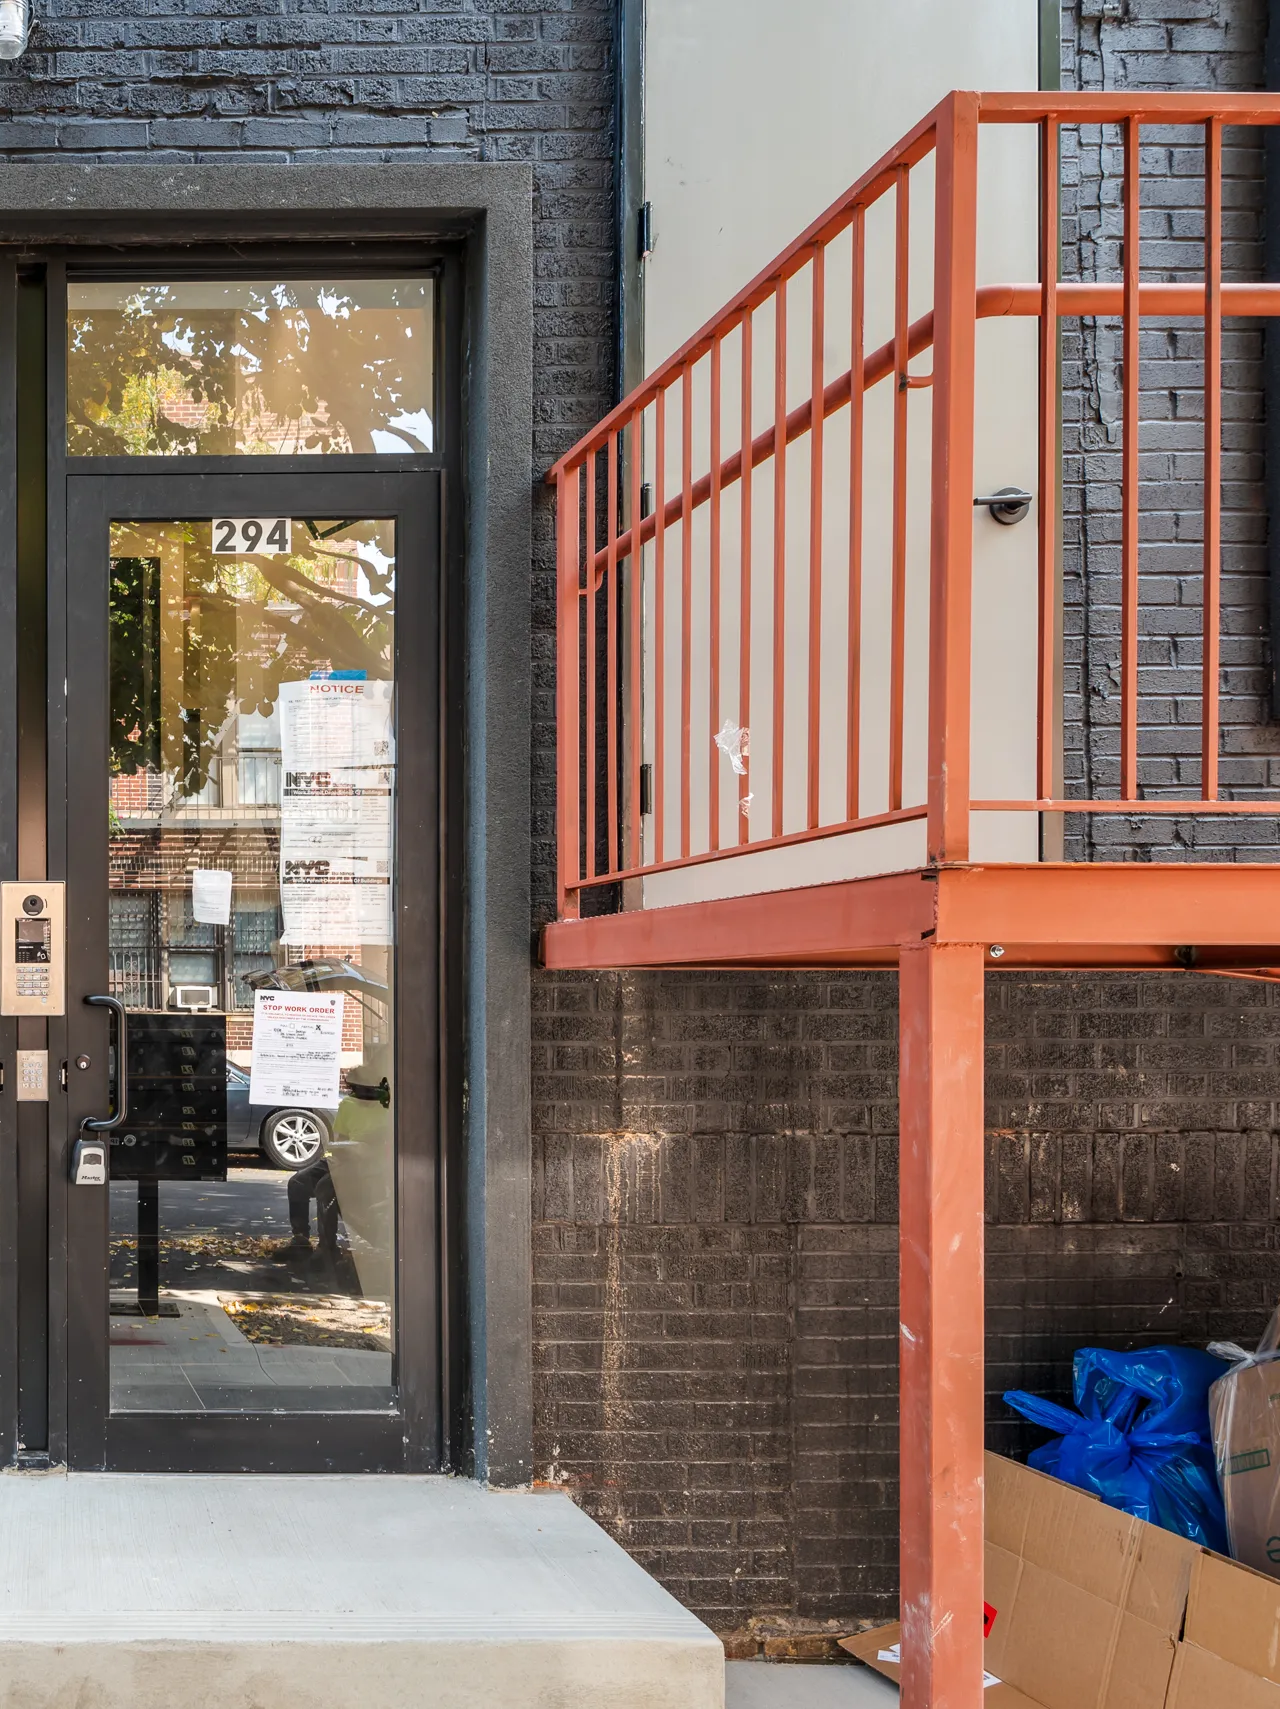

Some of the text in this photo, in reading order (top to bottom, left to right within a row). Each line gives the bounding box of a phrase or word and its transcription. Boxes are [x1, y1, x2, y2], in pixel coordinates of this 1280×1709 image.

[214, 520, 288, 552] 294
[310, 684, 364, 694] NOTICE
[285, 772, 331, 787] NYC
[285, 860, 330, 875] NYC
